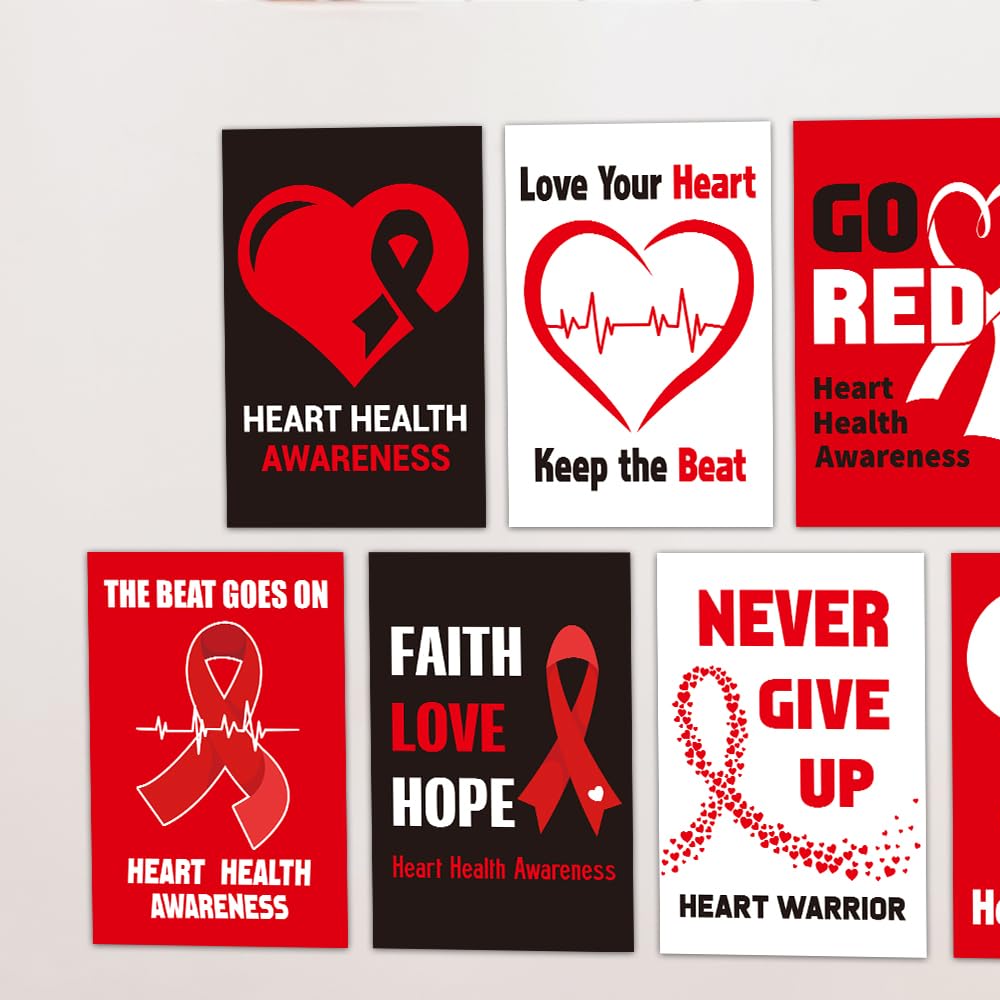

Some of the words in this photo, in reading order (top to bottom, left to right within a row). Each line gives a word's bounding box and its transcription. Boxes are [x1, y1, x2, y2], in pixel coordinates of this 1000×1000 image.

[521, 167, 587, 201] Love
[598, 166, 662, 200] Your
[674, 164, 756, 199] Heart
[813, 182, 918, 252] GO
[813, 267, 983, 345] RED
[814, 377, 893, 400] Heart
[244, 405, 342, 432] HEART
[351, 405, 467, 432] HEALTH
[814, 410, 907, 434] Health
[262, 444, 450, 472] AWARENESS
[535, 448, 607, 491] Keep
[618, 448, 667, 482] the
[679, 448, 746, 481] Beat
[816, 446, 970, 468] Awareness
[104, 580, 150, 608] THE
[157, 580, 216, 608] BEAT
[223, 580, 287, 609] GOES
[295, 580, 328, 609] ON
[699, 590, 889, 647] NEVER
[391, 627, 521, 676] FAITH
[759, 679, 890, 730] GIVE
[392, 702, 505, 752] LOVE
[800, 759, 874, 808] UP
[393, 777, 515, 827] HOPE
[128, 858, 205, 884] HEART
[221, 859, 311, 886] HEALTH
[393, 855, 442, 878] Heart
[450, 856, 505, 879] Health
[514, 856, 616, 880] Awareness
[151, 893, 288, 919] AWARENESS
[680, 894, 768, 918] HEART
[777, 896, 905, 920] WARRIOR
